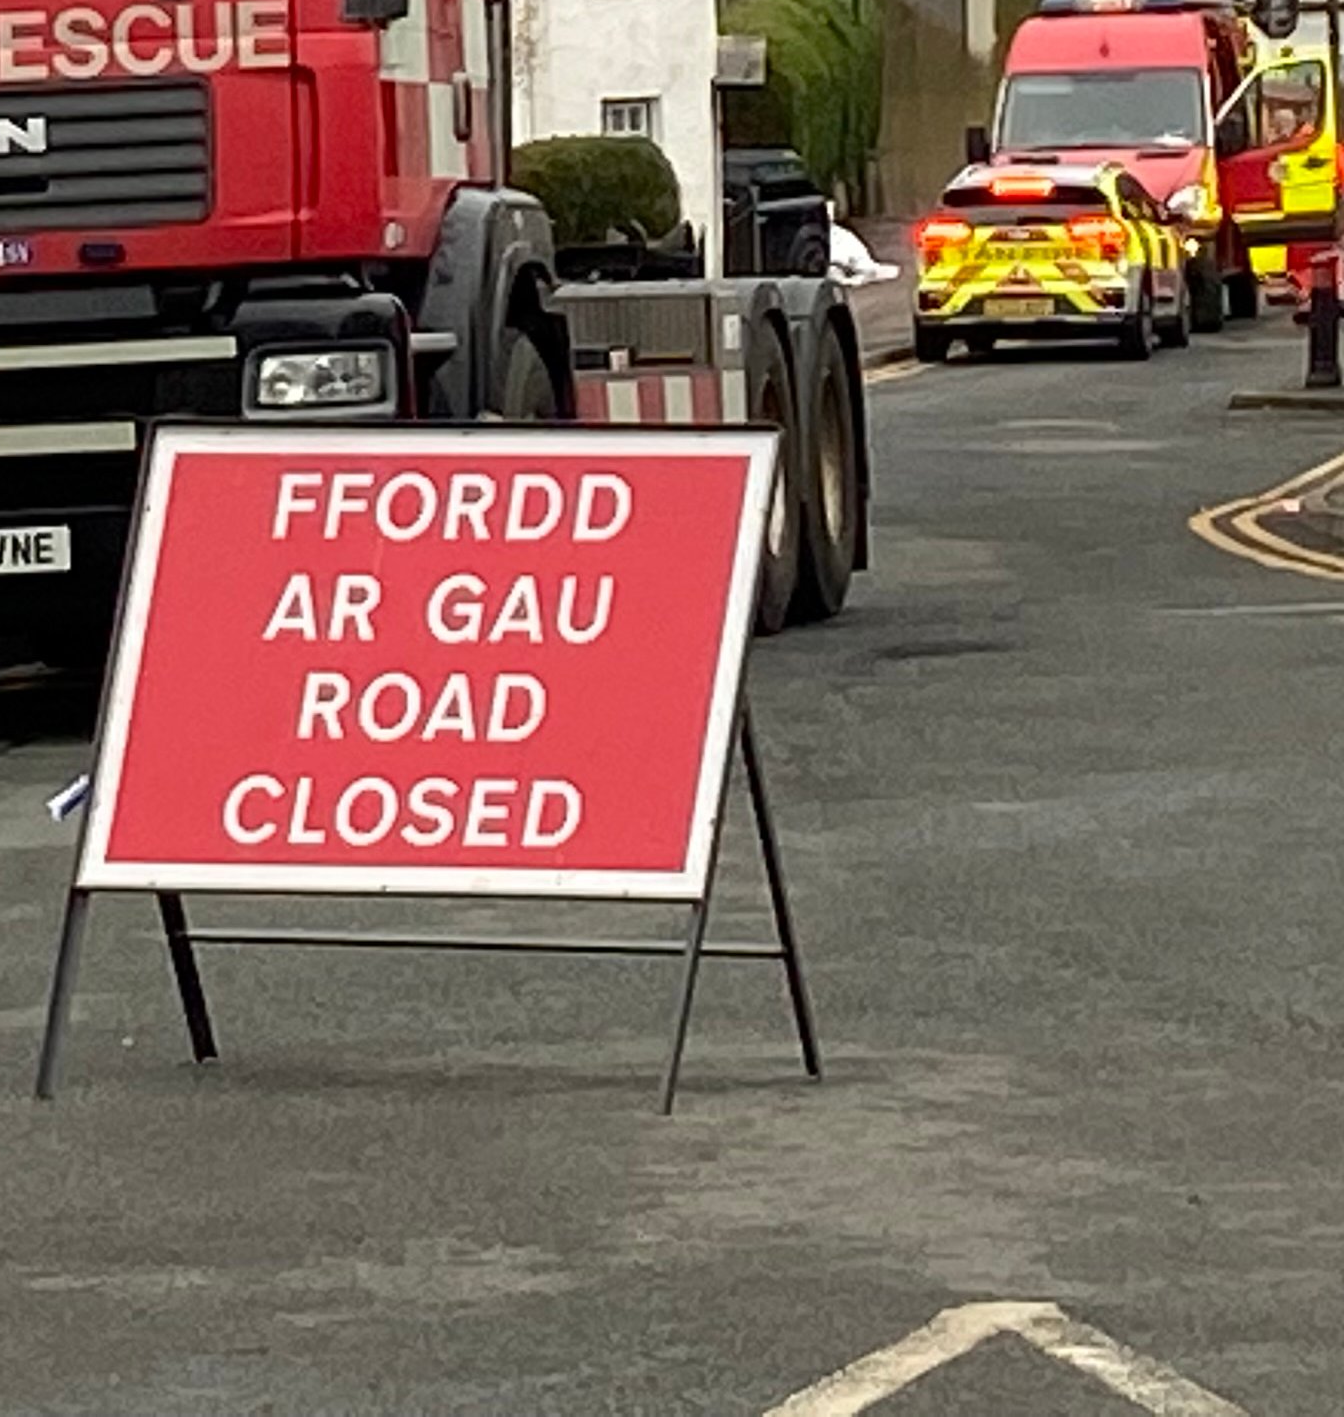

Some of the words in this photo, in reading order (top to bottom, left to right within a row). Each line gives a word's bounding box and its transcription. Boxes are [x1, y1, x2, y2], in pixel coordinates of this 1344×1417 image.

[271, 472, 633, 541] FFORDD
[262, 574, 382, 642] AR
[427, 574, 616, 644] GAU
[297, 671, 547, 742] ROAD
[223, 774, 582, 847] CLOSED
